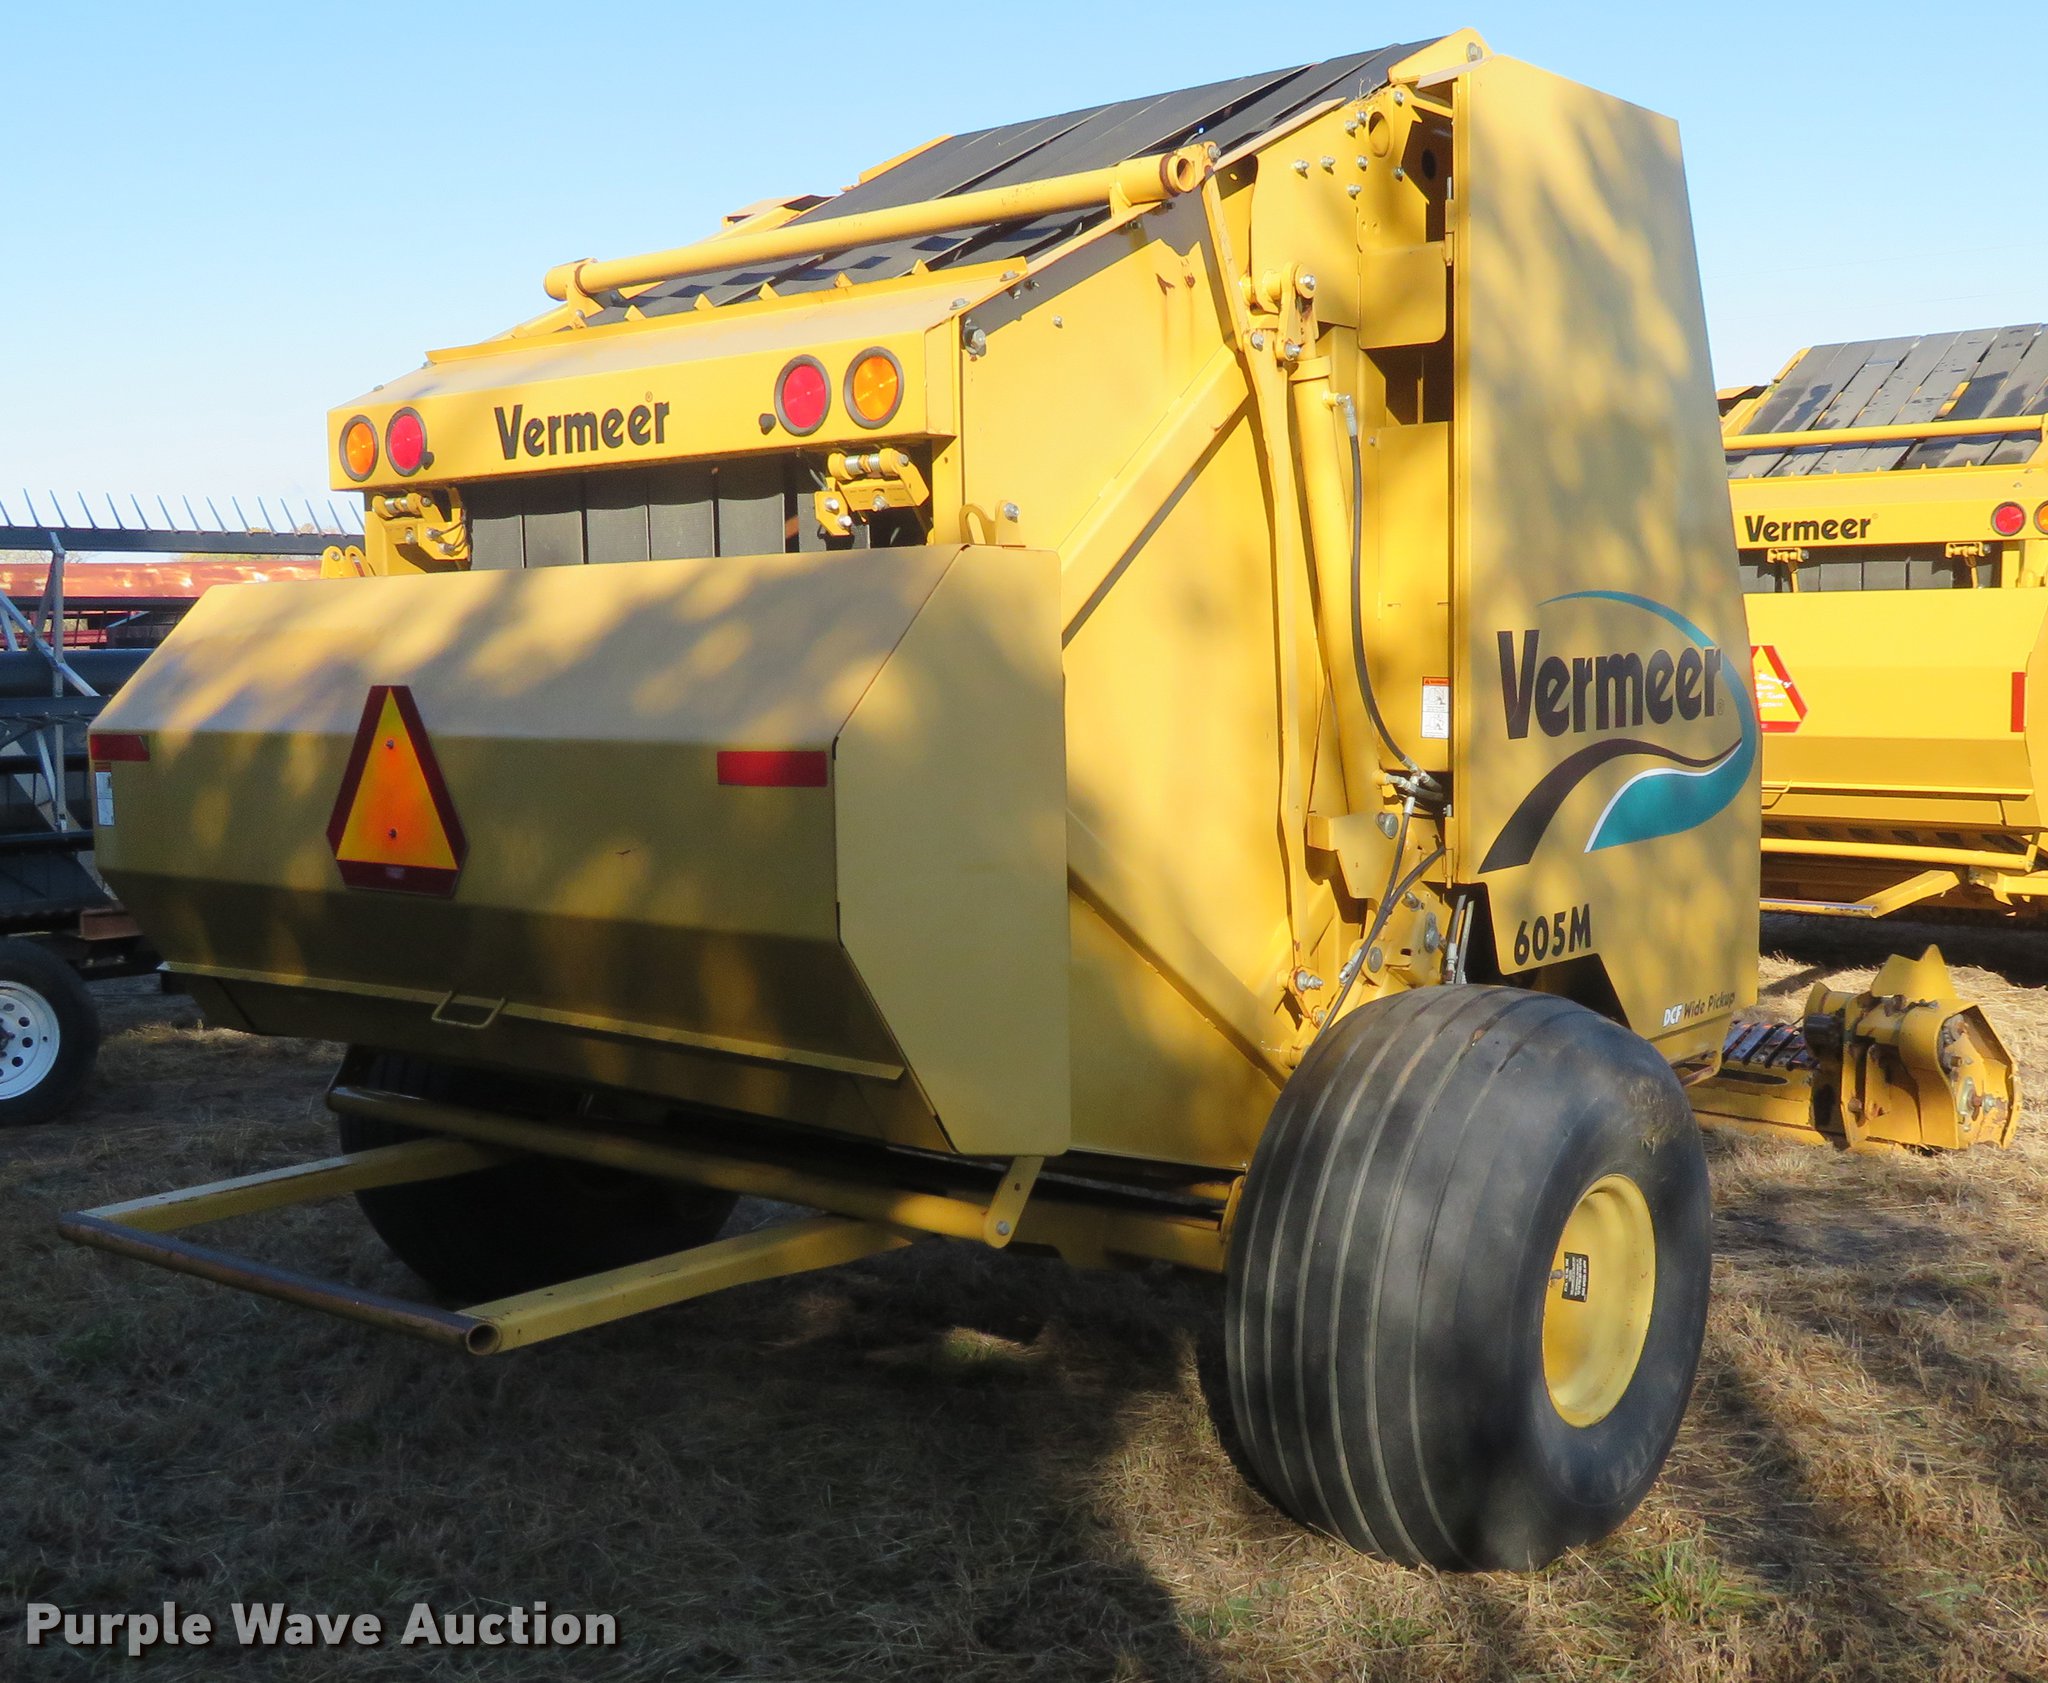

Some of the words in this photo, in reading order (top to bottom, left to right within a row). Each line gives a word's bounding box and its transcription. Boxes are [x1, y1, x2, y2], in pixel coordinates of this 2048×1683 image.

[494, 401, 670, 461] Vermeer
[1744, 514, 1872, 543] Vermeer
[1496, 629, 1722, 740] Vermeer
[1513, 903, 1592, 966] 605M
[1662, 1004, 1683, 1027] DCF
[1683, 999, 1706, 1019] Wide
[1707, 991, 1736, 1012] Pickup
